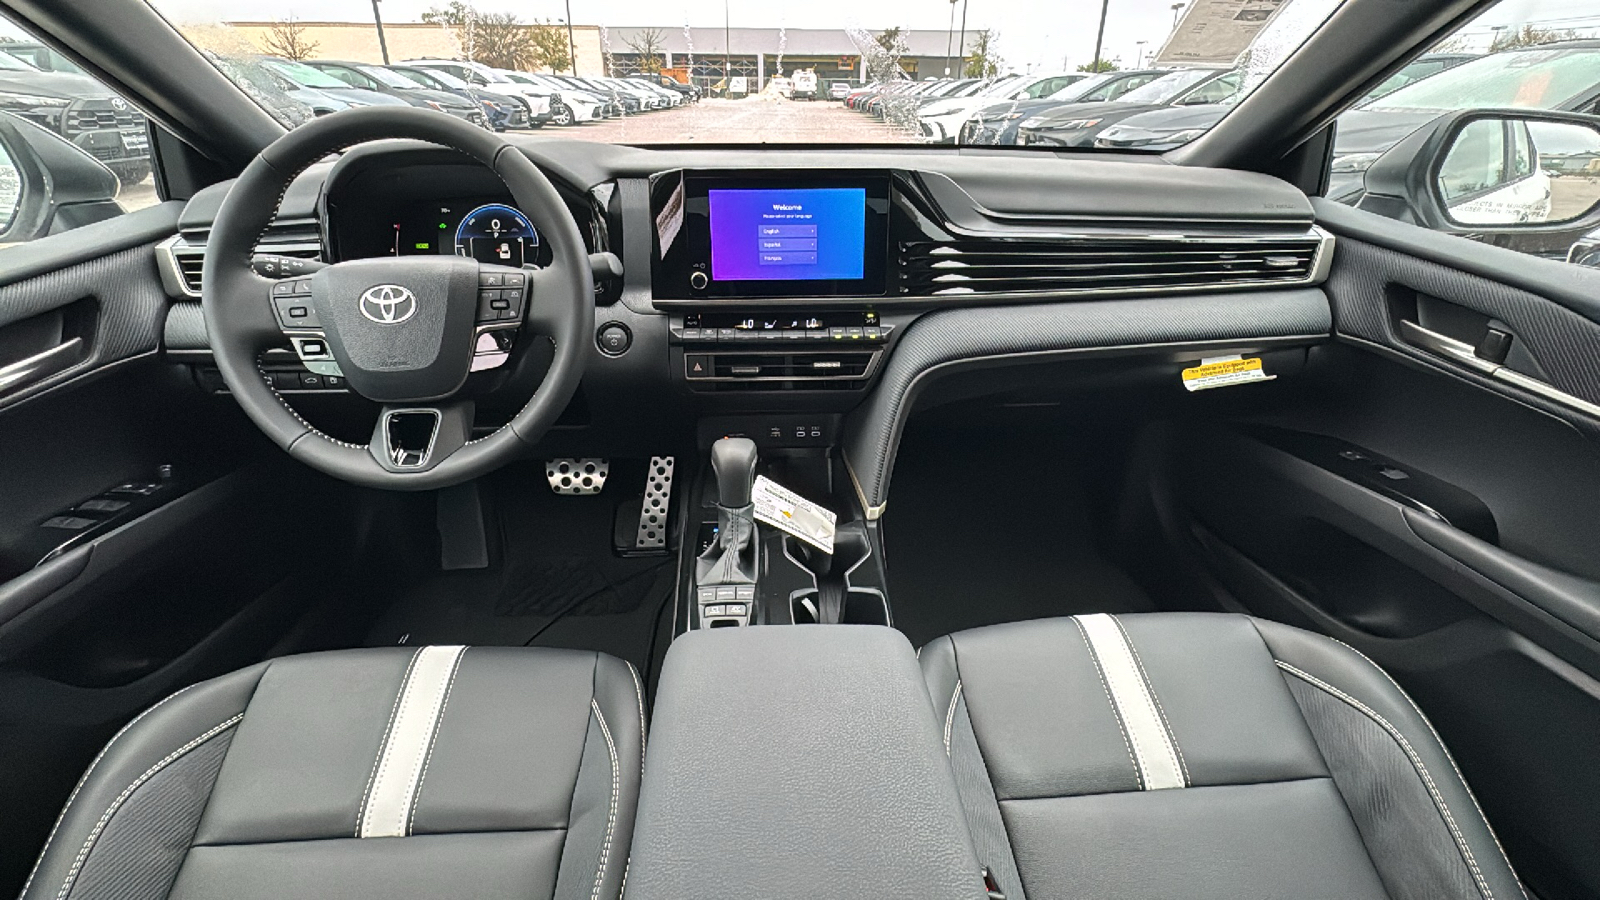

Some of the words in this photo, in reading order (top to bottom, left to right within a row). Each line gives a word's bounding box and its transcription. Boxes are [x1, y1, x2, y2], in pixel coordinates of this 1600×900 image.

[772, 203, 803, 211] Welcome
[491, 218, 501, 230] 0
[1222, 361, 1245, 370] Equipped
